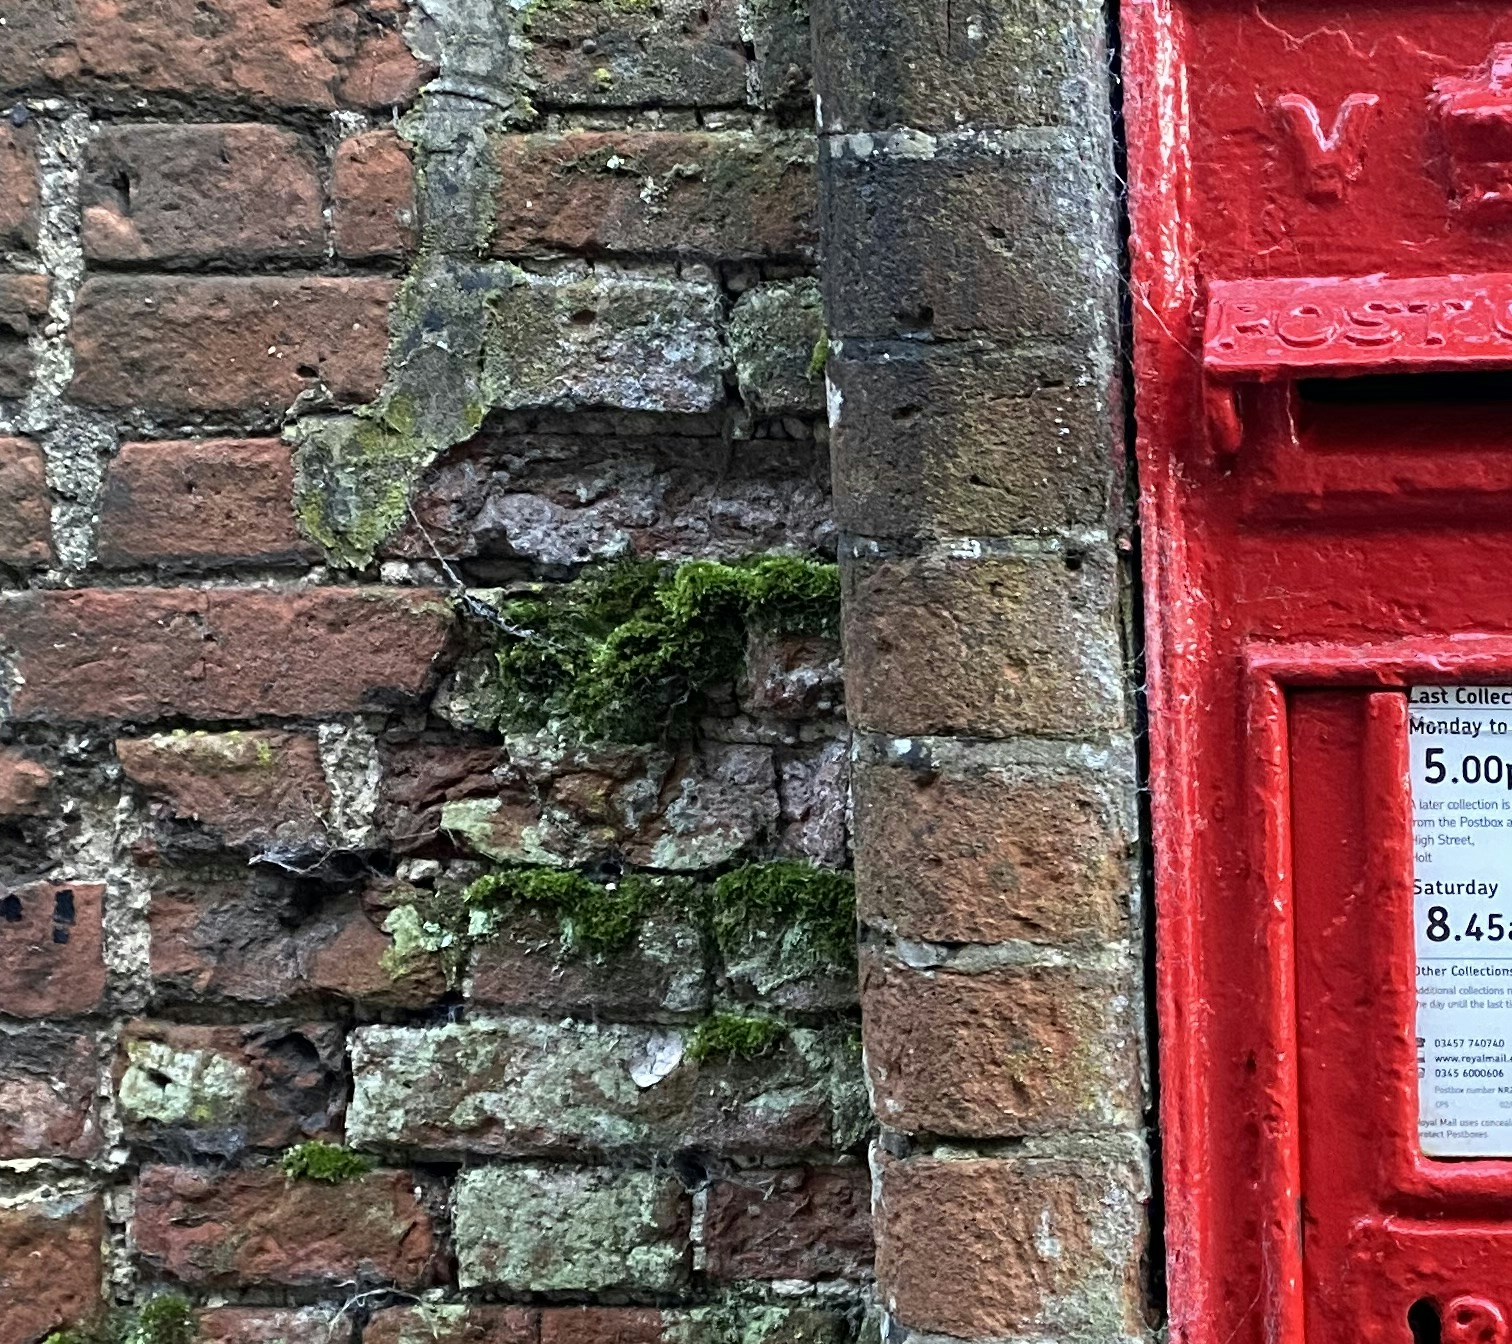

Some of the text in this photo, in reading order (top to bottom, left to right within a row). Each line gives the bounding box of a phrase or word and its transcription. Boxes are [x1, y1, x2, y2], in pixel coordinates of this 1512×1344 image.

[1274, 90, 1382, 204] V
[1212, 296, 1474, 353] POST
[1409, 716, 1482, 738] Monday
[1489, 718, 1507, 734] to
[1419, 798, 1445, 810] later
[1447, 798, 1499, 810] collection
[1501, 798, 1511, 810] is
[1413, 819, 1435, 828] rom
[1438, 816, 1456, 827] the
[1460, 816, 1504, 828] Postbox
[1438, 833, 1475, 846] Street,
[1413, 878, 1499, 899] Saturday
[1417, 986, 1457, 995] dditional
[1459, 985, 1505, 995] collections
[1430, 999, 1445, 1010] day
[1470, 999, 1485, 1009] the
[1487, 999, 1503, 1009] last
[1434, 1038, 1505, 1048] 03457 740740
[1434, 1068, 1504, 1078] 0345 6000606
[1440, 1118, 1457, 1127] Mail
[1459, 1119, 1479, 1127] uses
